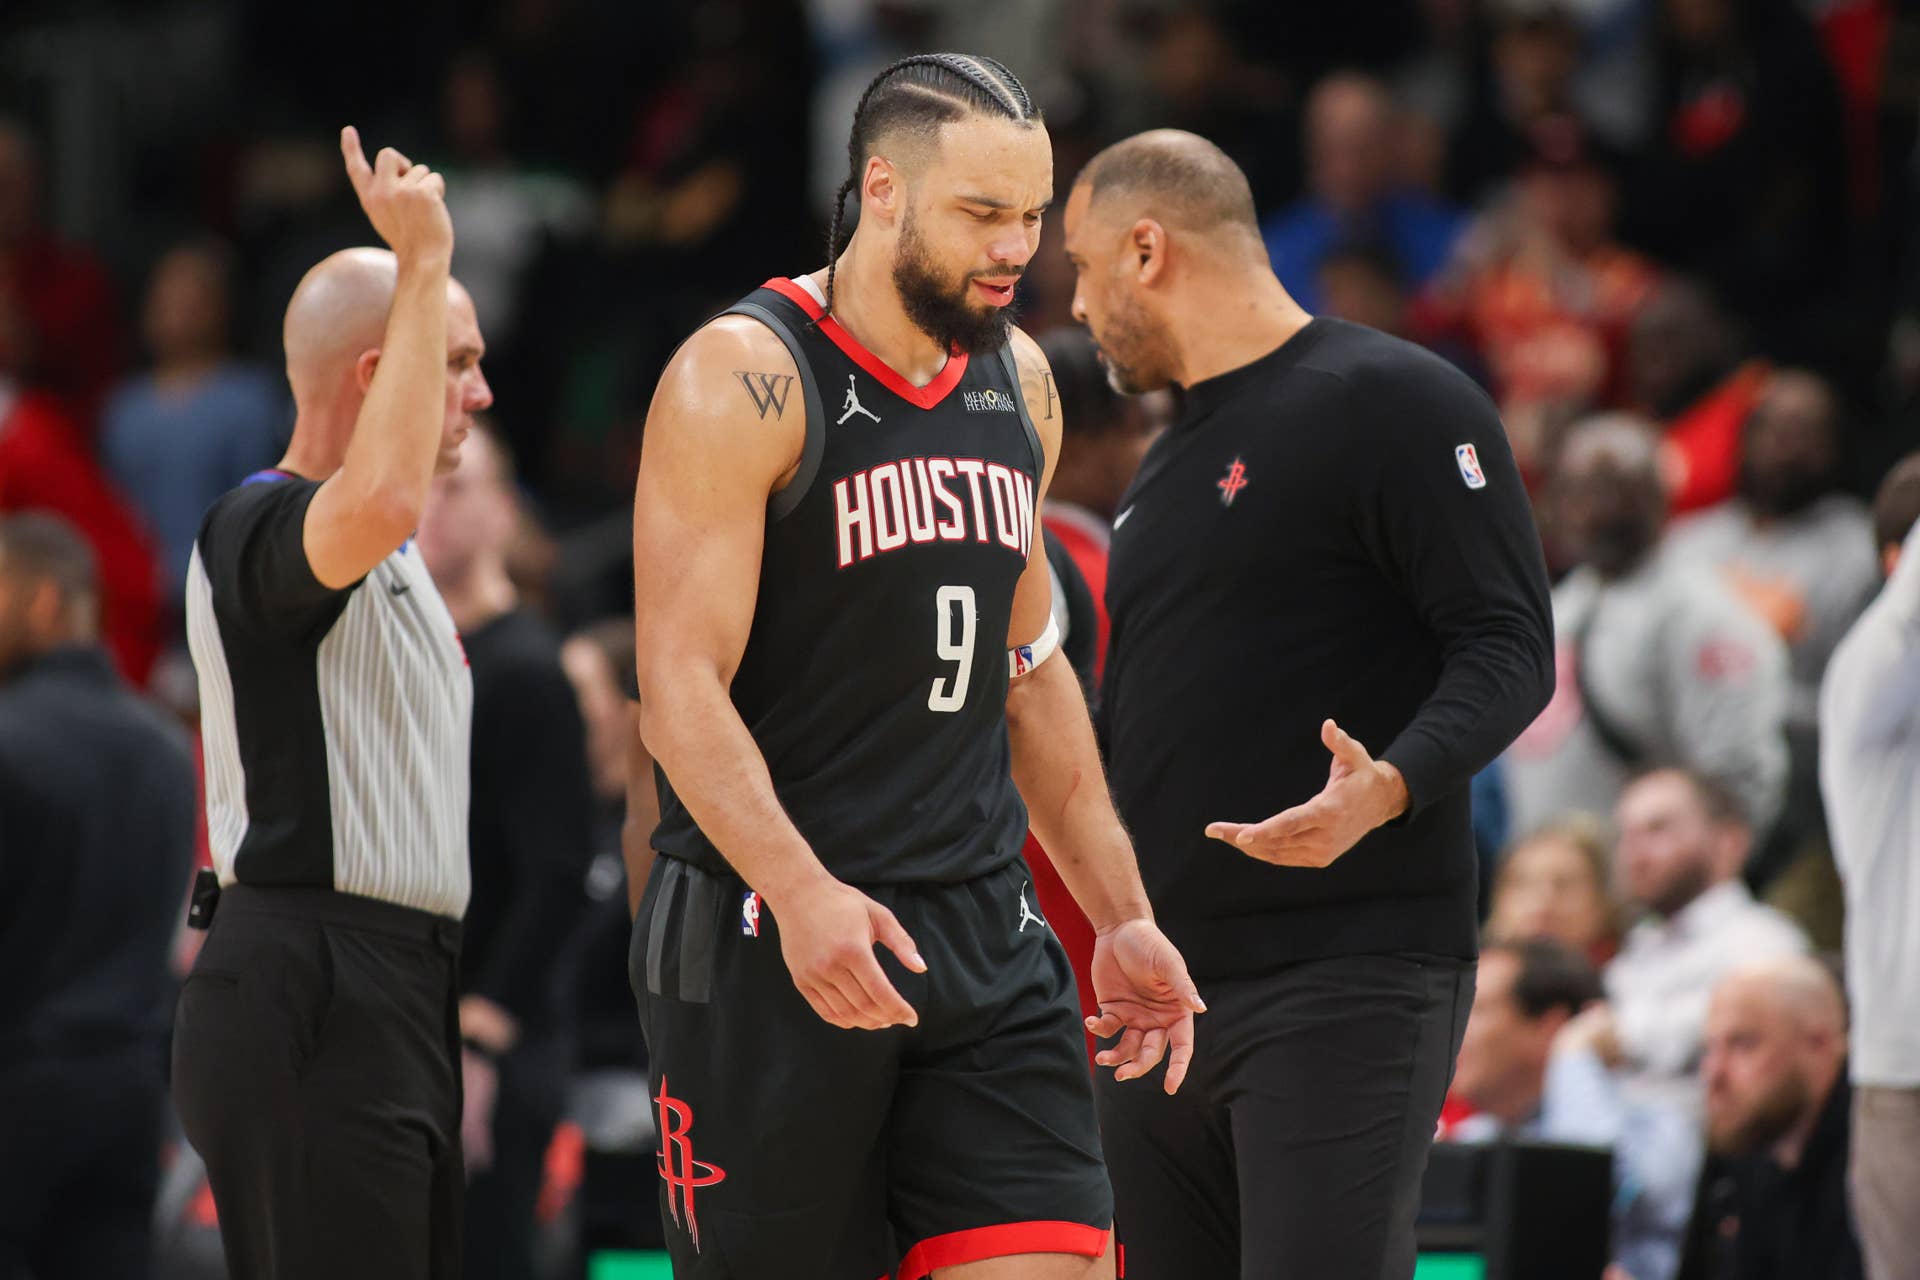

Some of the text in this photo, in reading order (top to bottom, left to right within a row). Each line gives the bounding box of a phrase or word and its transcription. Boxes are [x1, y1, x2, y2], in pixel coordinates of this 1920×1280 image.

[963, 389, 1013, 404] MEMORIAL
[965, 399, 1016, 412] HERMANN
[833, 456, 1034, 568] HOUSTON
[928, 585, 976, 712] 9
